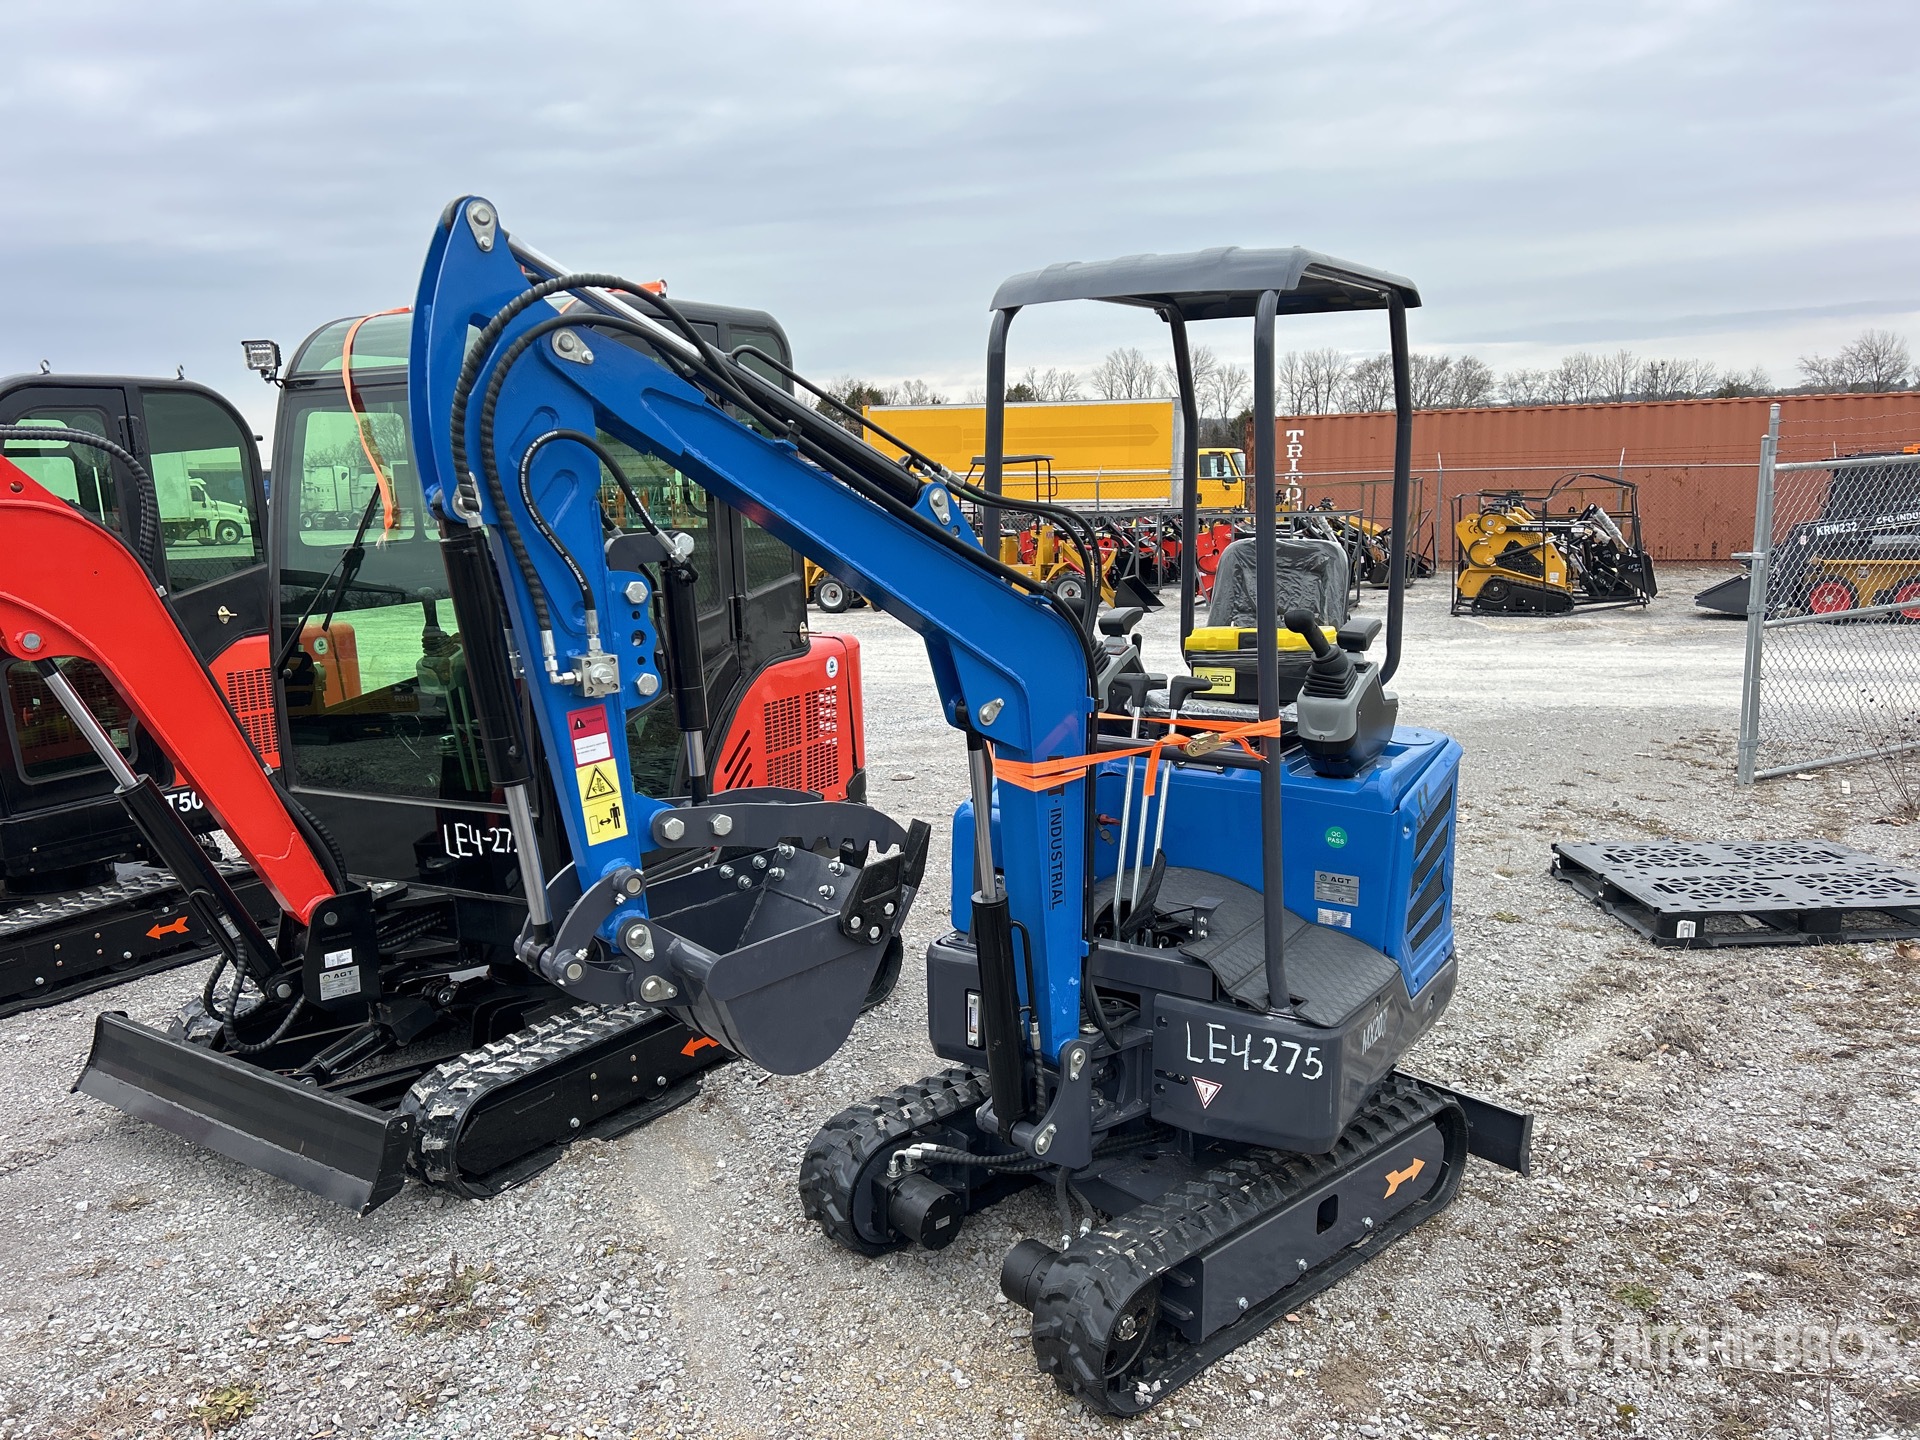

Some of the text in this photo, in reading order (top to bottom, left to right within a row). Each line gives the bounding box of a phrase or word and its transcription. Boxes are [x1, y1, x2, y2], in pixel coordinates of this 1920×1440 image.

[1896, 511, 1920, 521] INDU
[1816, 521, 1857, 536] KRW232
[443, 822, 518, 859] LE4-27
[1327, 837, 1345, 845] PASS
[1050, 807, 1064, 910] INDUSTRIAL
[1330, 876, 1352, 885] AGT
[333, 969, 354, 979] AGT
[1186, 1021, 1324, 1081] LE4-275
